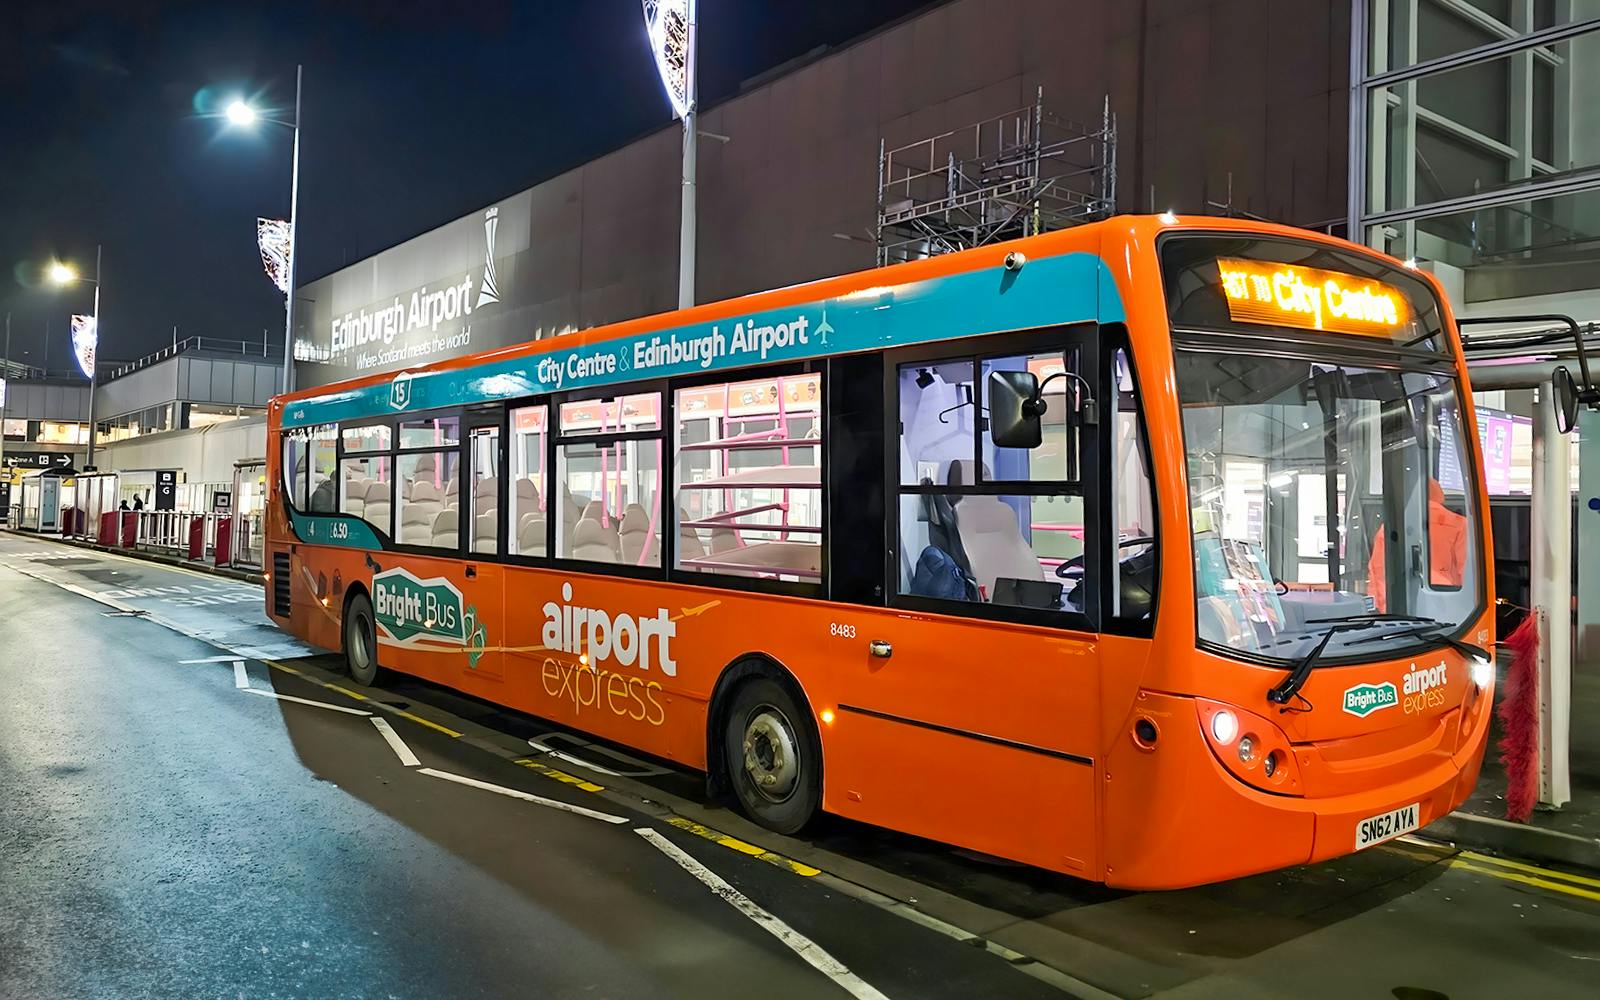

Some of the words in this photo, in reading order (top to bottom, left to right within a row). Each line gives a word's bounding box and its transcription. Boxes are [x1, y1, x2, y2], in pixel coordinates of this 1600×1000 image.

[331, 297, 404, 352] Edinburgh
[406, 274, 472, 332] Airport
[1273, 269, 1323, 330] City
[1324, 279, 1398, 325] Centre
[356, 351, 377, 370] Where
[377, 342, 408, 366] Scotland
[408, 338, 431, 358] meets
[431, 334, 446, 353] the
[446, 325, 471, 348] world
[537, 355, 564, 389] City
[567, 350, 616, 380] Centre
[619, 346, 630, 372] &
[633, 325, 726, 369] Edinburgh
[729, 315, 809, 359] Airport
[395, 382, 405, 403] 15
[162, 486, 170, 495] G
[376, 583, 423, 627] Bright
[425, 592, 456, 629] Bus
[541, 581, 677, 676] airport
[830, 622, 856, 639] 8483
[541, 658, 665, 726] express
[1402, 660, 1447, 695] airport
[1347, 691, 1377, 709] Bright
[1377, 688, 1393, 703] Bus
[1402, 687, 1445, 716] express
[1361, 812, 1391, 843] SN62
[1393, 807, 1414, 833] AYA
